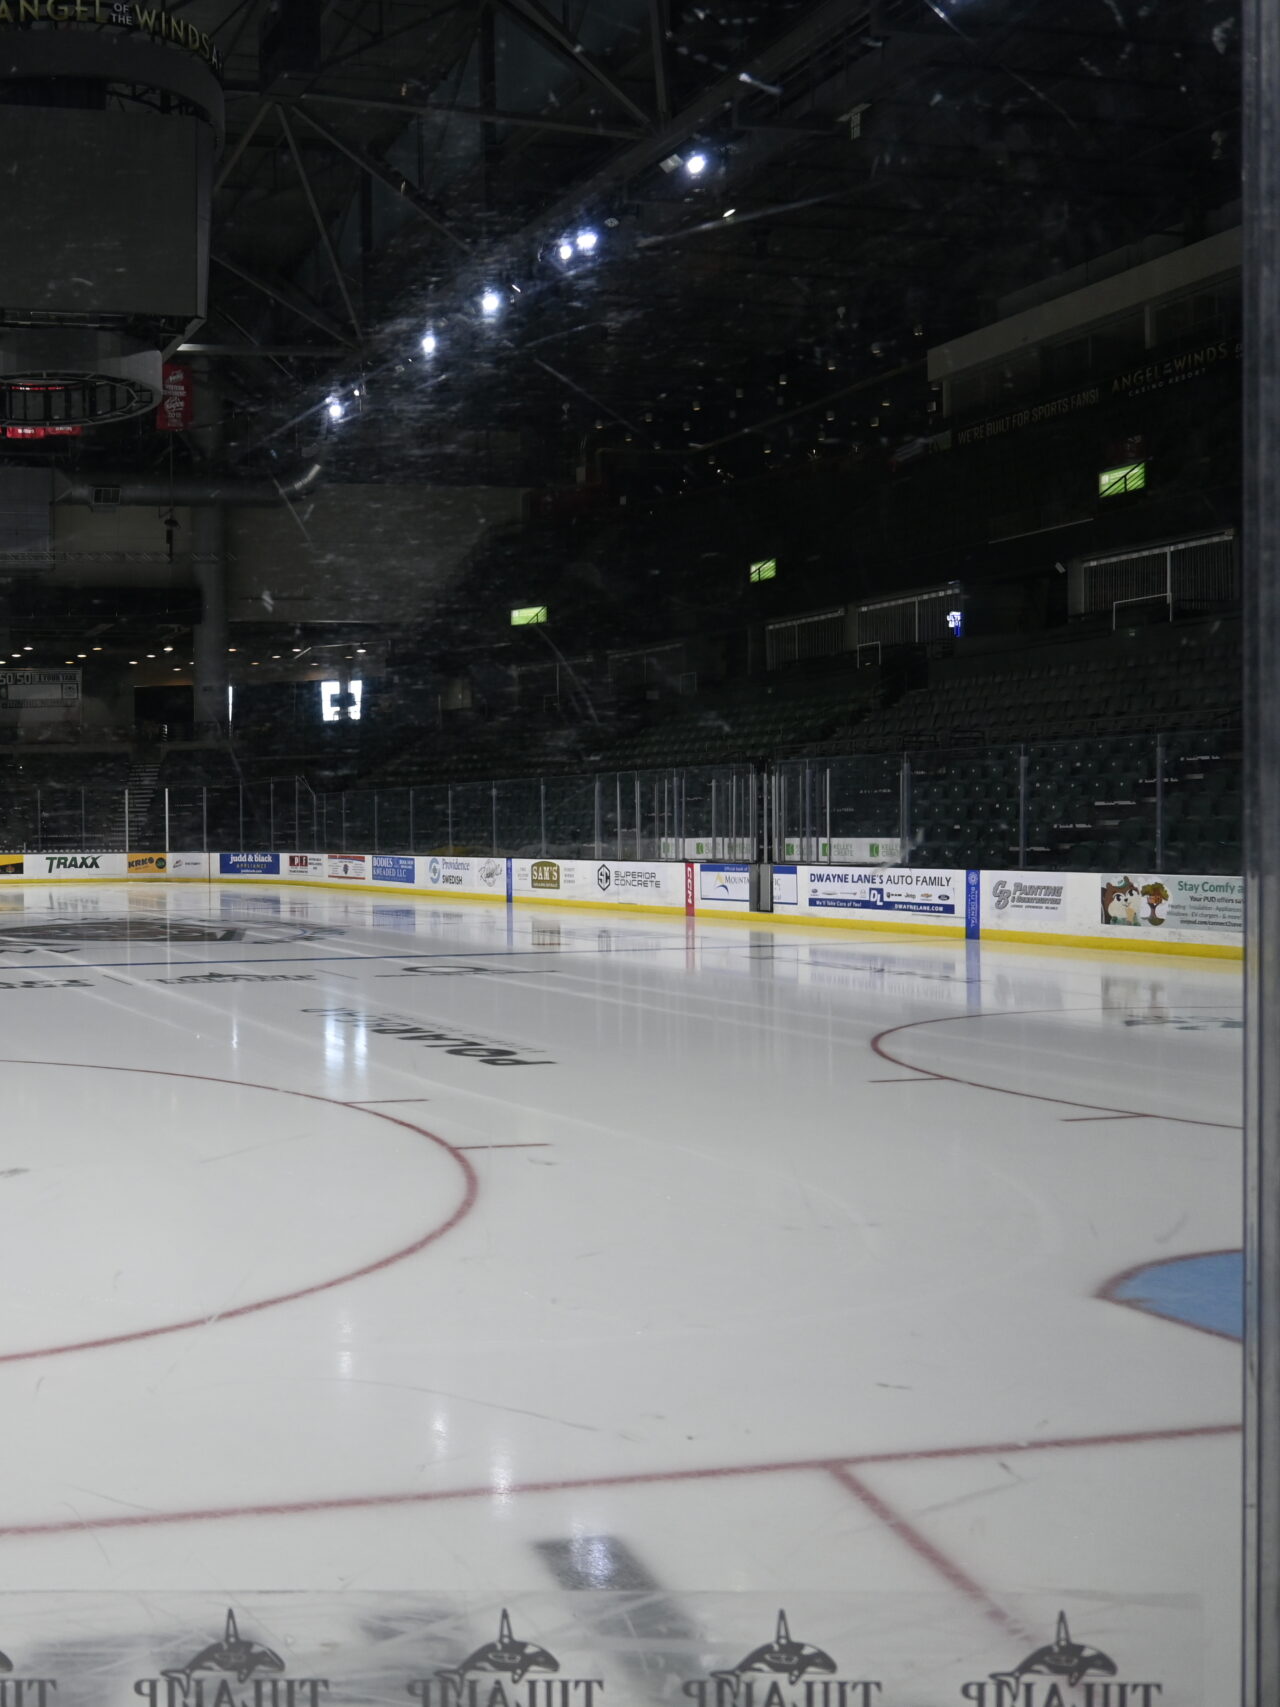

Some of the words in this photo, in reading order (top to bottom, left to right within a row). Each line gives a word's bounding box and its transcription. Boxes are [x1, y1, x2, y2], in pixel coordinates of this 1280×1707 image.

[113, 3, 129, 13] OF
[110, 13, 133, 25] THE
[135, 4, 210, 59] WINDS
[1112, 367, 1158, 393] ANGEL
[1174, 343, 1228, 372] WINDS
[958, 424, 984, 445] WE'RE
[986, 416, 1010, 437] BUILT
[1012, 410, 1029, 428] FOR
[1031, 401, 1070, 421] SPORTS
[1070, 388, 1100, 409] FANS!
[46, 855, 102, 874] TRAXX
[230, 853, 247, 864] judd
[248, 854, 254, 862] &
[255, 853, 272, 863] black
[373, 857, 393, 867] BODIES
[442, 859, 470, 871] Providence
[532, 866, 558, 880] SAM'S
[614, 871, 656, 880] SUPERIOR
[442, 875, 463, 885] SWEDISH
[614, 879, 661, 888] CONCRETE
[810, 873, 849, 883] DWAYNE
[851, 874, 883, 884] LANE'S
[886, 875, 913, 885] AUTO
[916, 876, 952, 887] FAMILY
[1013, 882, 1064, 897] PAINTING
[1178, 880, 1200, 893] Stay
[1201, 881, 1236, 894] Comfy
[895, 903, 944, 912] DWAYNELANE.COM
